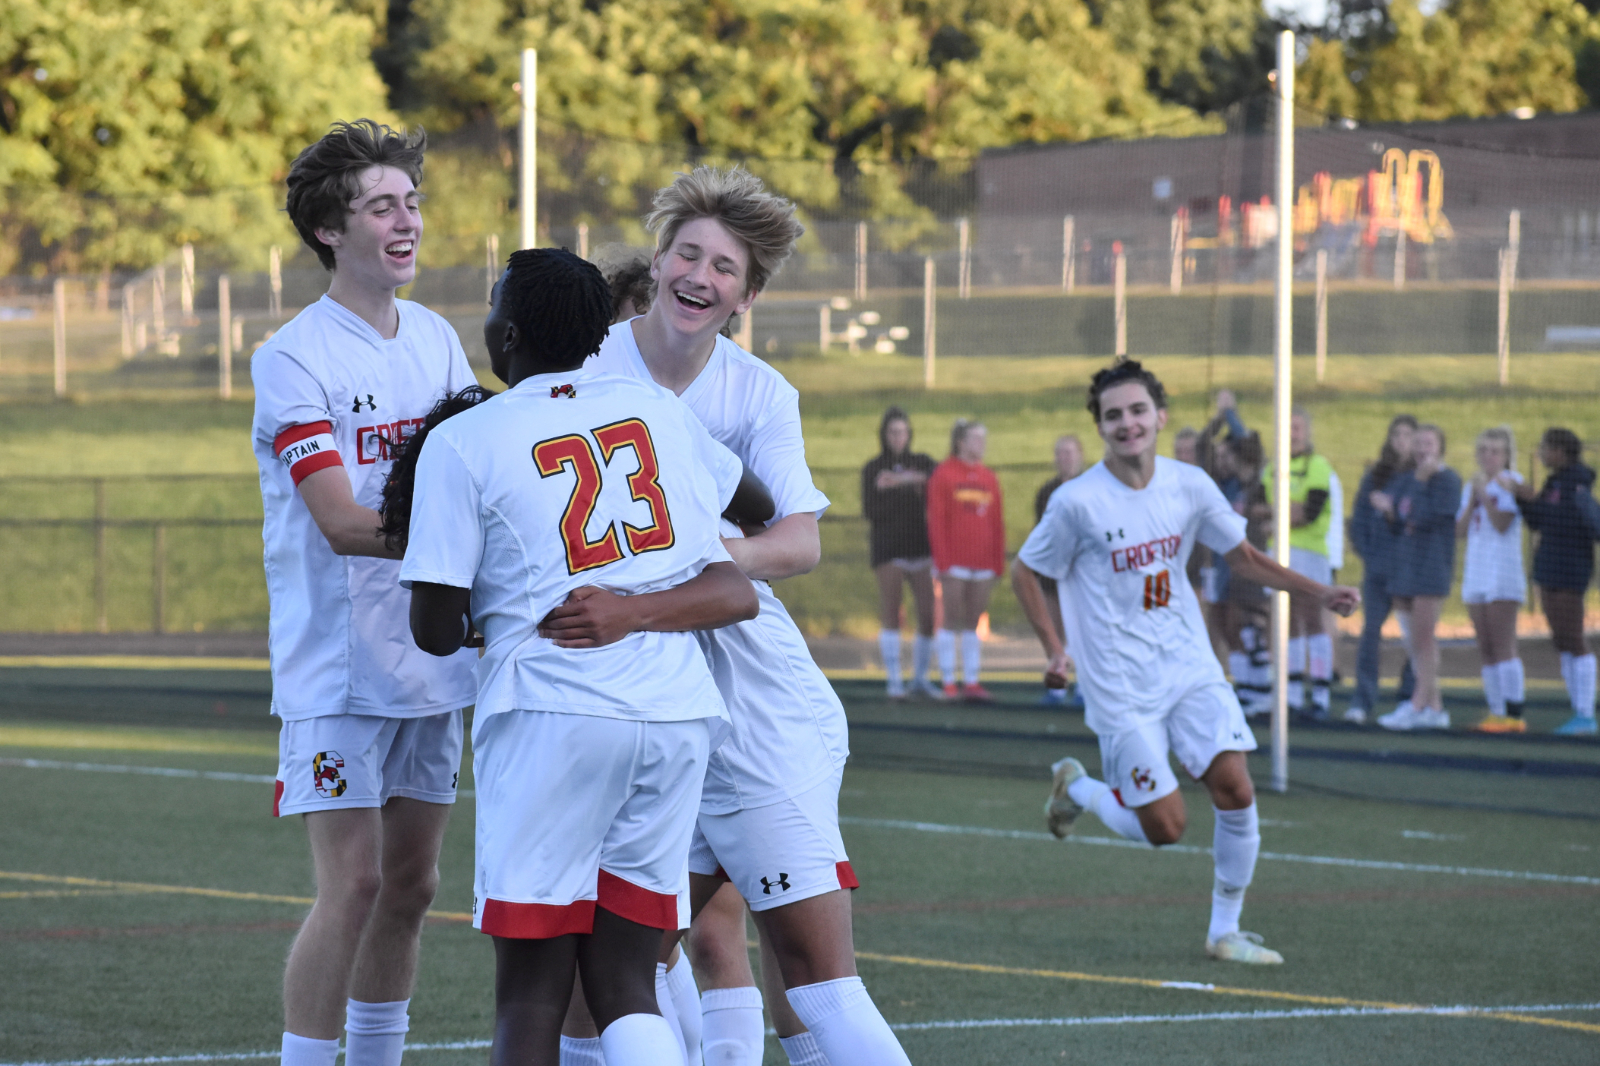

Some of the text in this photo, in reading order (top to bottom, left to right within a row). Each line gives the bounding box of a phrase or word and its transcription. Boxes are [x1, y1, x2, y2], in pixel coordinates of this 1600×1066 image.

[282, 440, 321, 468] APTAIN
[532, 417, 675, 576] 23
[1143, 569, 1171, 611] 10
